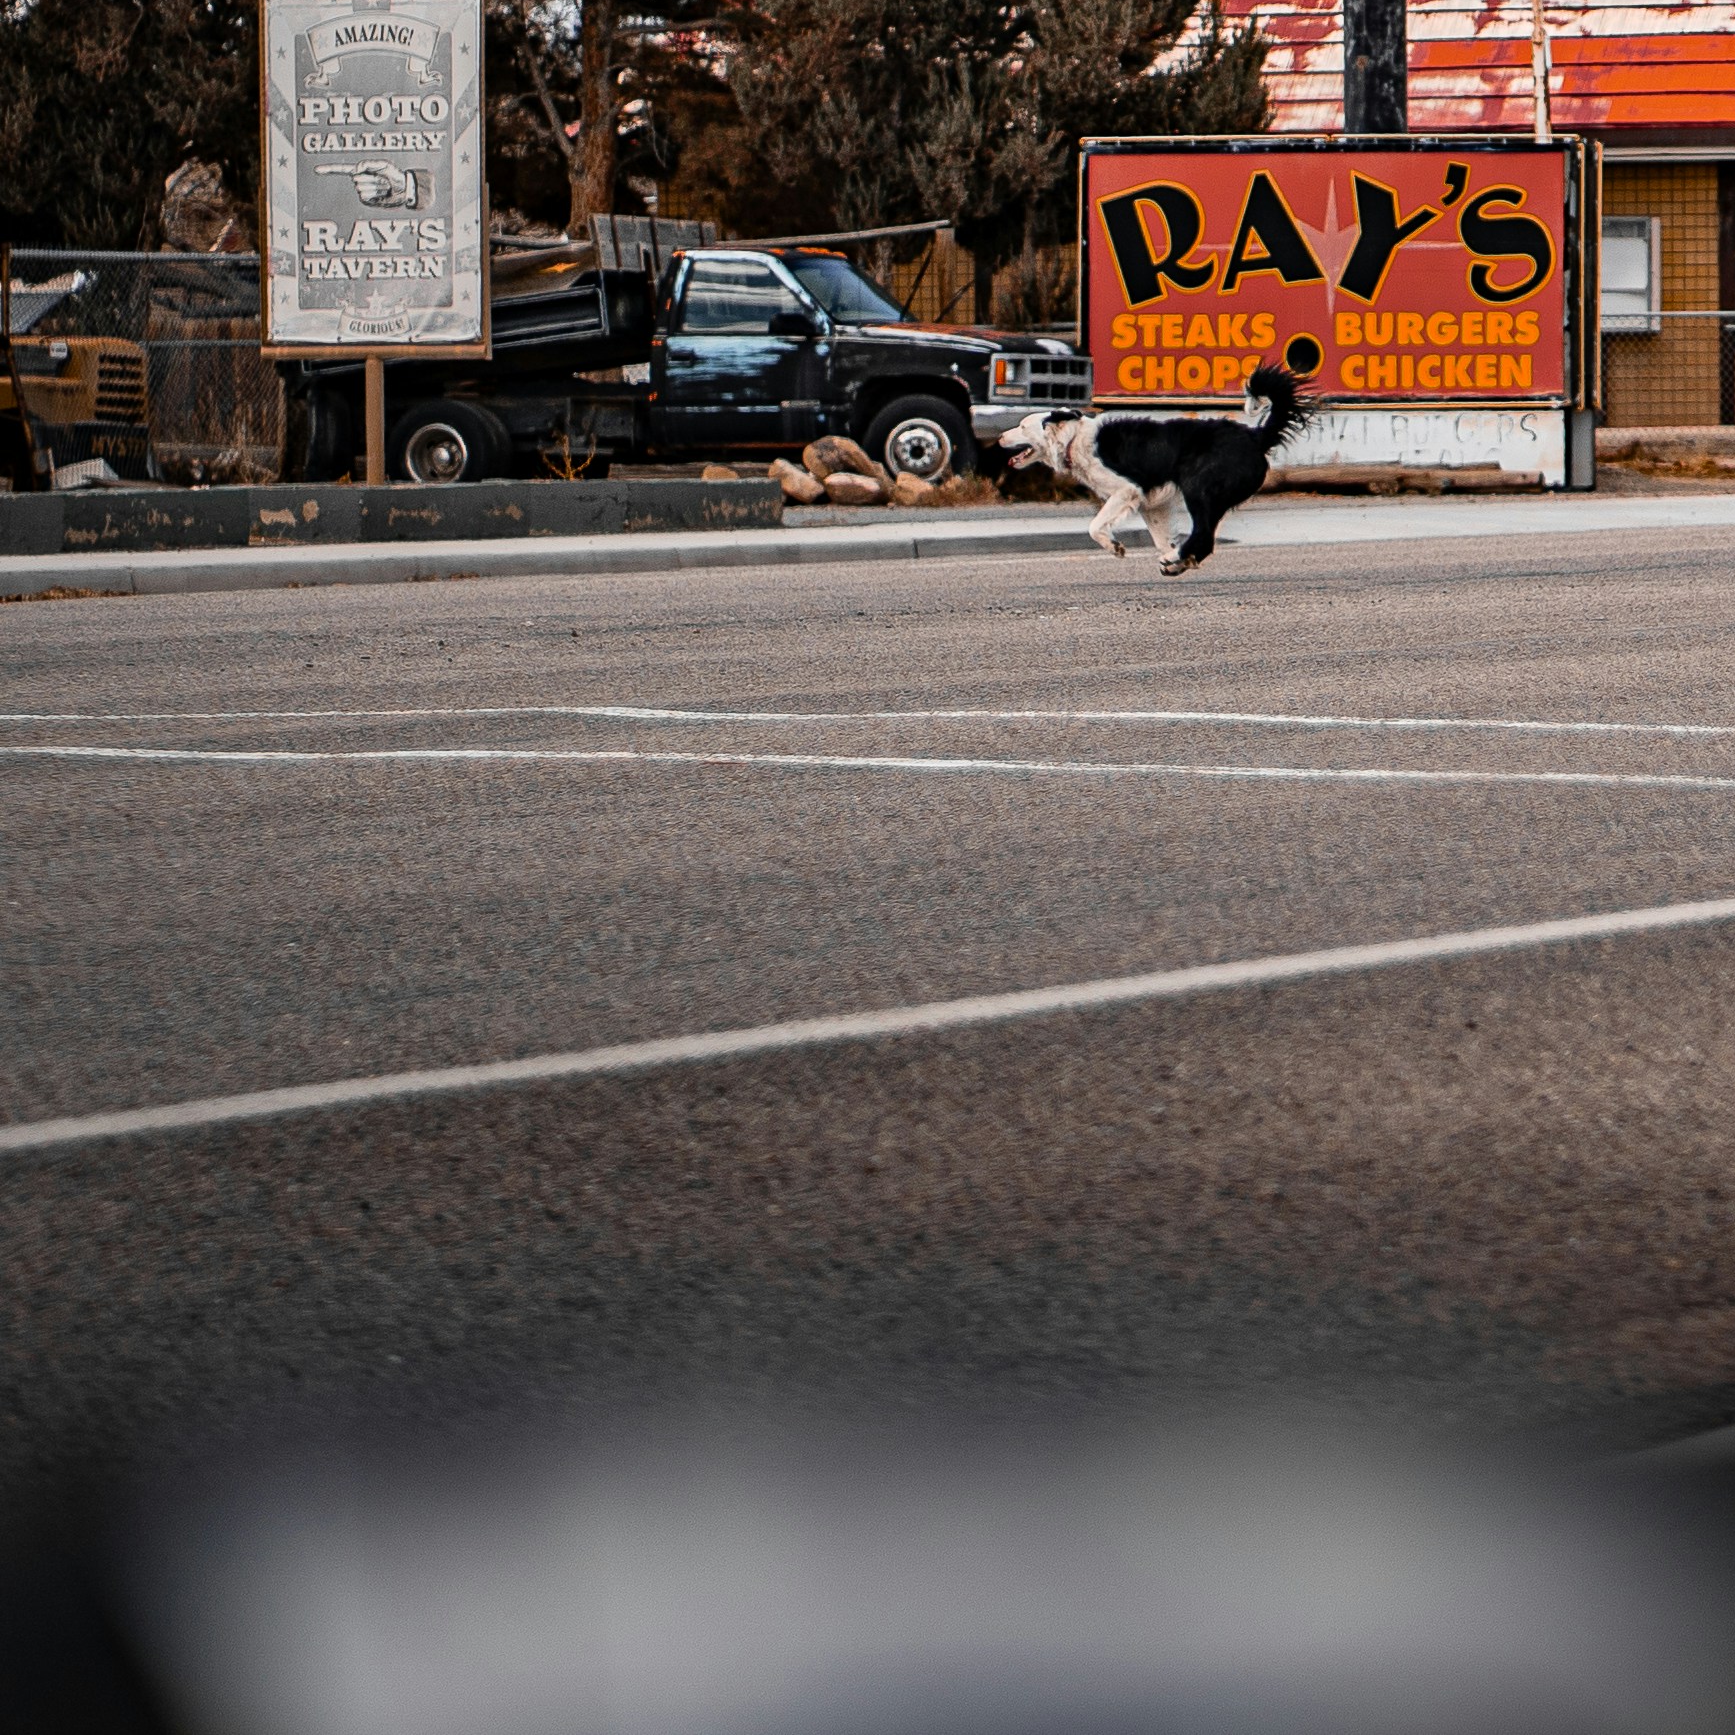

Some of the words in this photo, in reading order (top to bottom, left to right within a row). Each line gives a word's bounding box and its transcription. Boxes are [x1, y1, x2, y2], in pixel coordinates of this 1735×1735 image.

[334, 23, 415, 47] AMAZING!
[298, 93, 449, 126] PHOTO
[302, 130, 447, 153] GALLERY
[302, 218, 448, 253] RAY'S
[1096, 161, 1557, 308] RAY'S
[302, 255, 447, 280] TAVERN
[1111, 312, 1276, 350] STEAKS
[1335, 311, 1540, 349] BURGERS
[1340, 353, 1534, 390] CHICKEN
